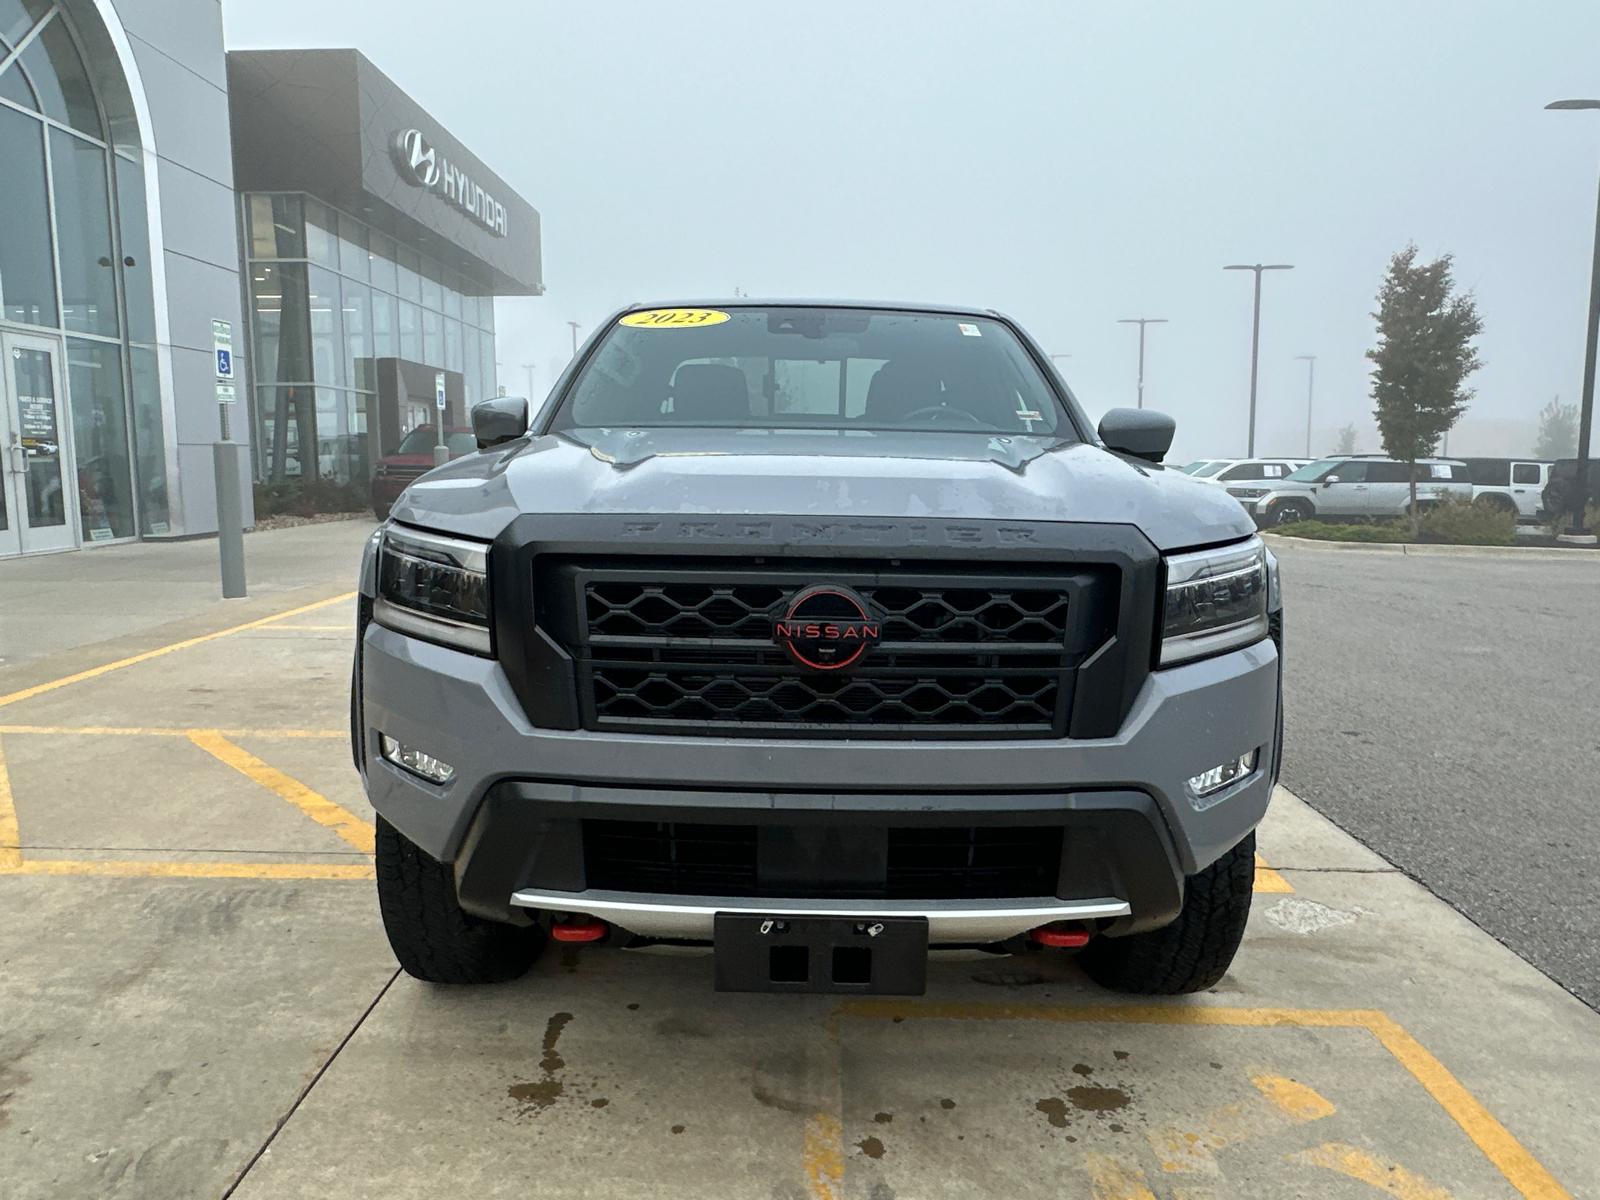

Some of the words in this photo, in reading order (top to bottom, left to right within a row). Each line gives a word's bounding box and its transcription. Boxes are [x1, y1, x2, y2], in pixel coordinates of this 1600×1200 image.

[443, 158, 507, 237] HYUNDAI
[634, 312, 712, 324] 2023
[776, 623, 878, 639] NISSAN
